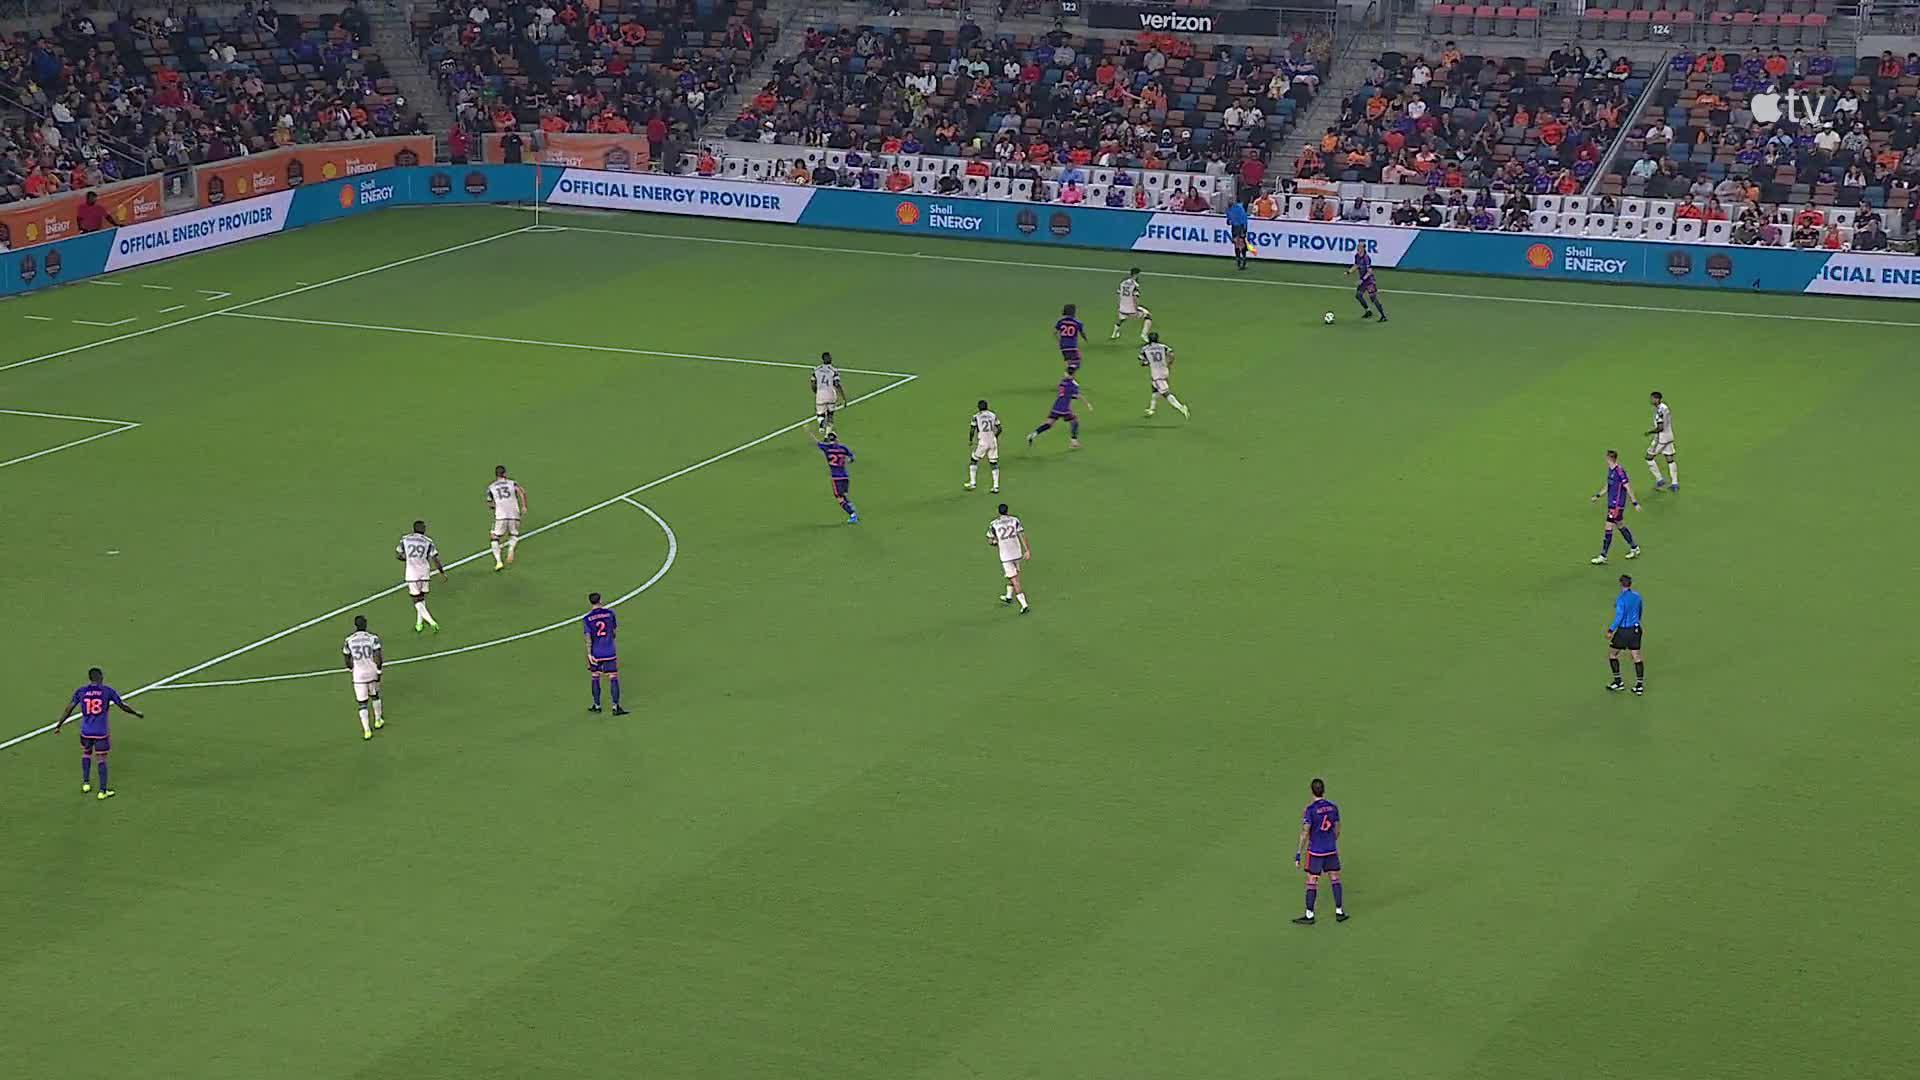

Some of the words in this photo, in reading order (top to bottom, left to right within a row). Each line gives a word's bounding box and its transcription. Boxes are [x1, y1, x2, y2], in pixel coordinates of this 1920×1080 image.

[1062, 2, 1077, 12] 123
[1139, 11, 1212, 32] verizon
[1652, 24, 1671, 35] 124
[360, 185, 395, 205] ENERGY
[559, 178, 629, 198] OFFICIAL
[632, 184, 696, 203] ENERGY
[699, 189, 782, 210] PROVIDER
[929, 204, 953, 215] Shell
[119, 231, 171, 255] OFFICIAL
[172, 218, 217, 243] ENERGY
[218, 206, 273, 233] PROVIDER
[929, 214, 983, 231] ENERGY
[1213, 228, 1284, 247] ENRGY
[1565, 245, 1593, 257] Shell
[1564, 256, 1627, 274] ENERGY
[1818, 264, 1876, 283] ICIAL
[1060, 324, 1076, 337] 20
[1151, 351, 1163, 362] 10
[982, 419, 994, 432] 21
[495, 486, 511, 500] 13
[998, 525, 1017, 540] 22
[407, 543, 426, 559] 29
[595, 621, 607, 637] 2
[351, 644, 372, 661] 30
[83, 698, 103, 715] 18
[1320, 814, 1332, 832] 6
